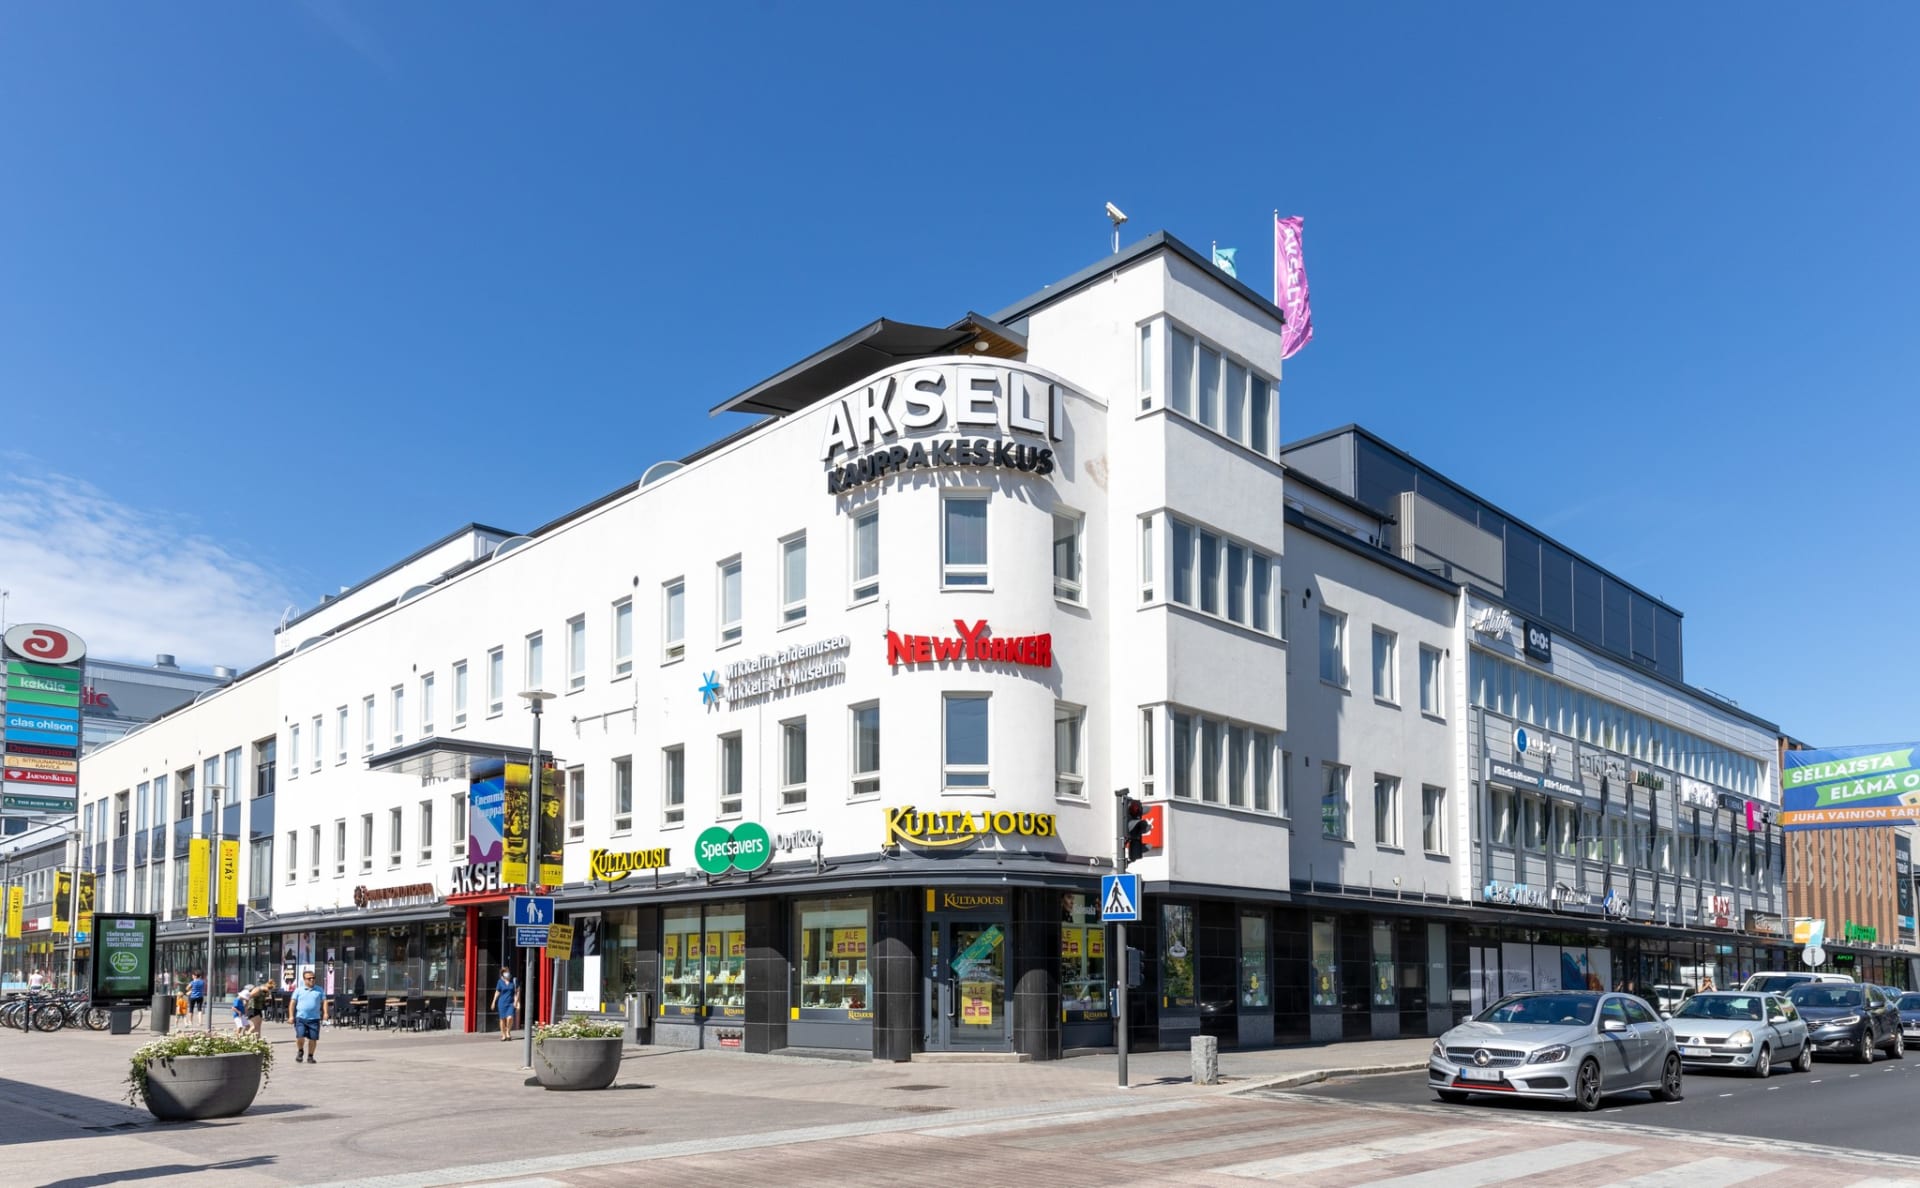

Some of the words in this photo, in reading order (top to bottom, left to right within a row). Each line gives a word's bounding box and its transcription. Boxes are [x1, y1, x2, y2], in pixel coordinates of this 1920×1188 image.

[1284, 227, 1302, 308] AKSELI
[820, 366, 1064, 463] AKSELI
[827, 438, 1054, 494] KAUPPAKESKUS
[725, 677, 766, 702] Mikkeli
[767, 672, 786, 691] Art
[788, 660, 845, 685] Museum
[10, 716, 34, 727] clas
[36, 719, 73, 731] ohlson
[1791, 755, 1895, 784] SELLAISTA
[1831, 774, 1898, 800] ELÄMÄ
[883, 804, 1057, 847] KULTAJOUSI
[1792, 812, 1825, 822] JUHA
[1828, 809, 1887, 820] VAINION
[701, 838, 763, 861] Specsavers
[589, 848, 668, 882] KULTAJOUSI
[943, 892, 1005, 910] KULTAJOUSI
[1713, 896, 1730, 915] RAX
[844, 930, 859, 940] ALE
[968, 986, 986, 995] ALE
